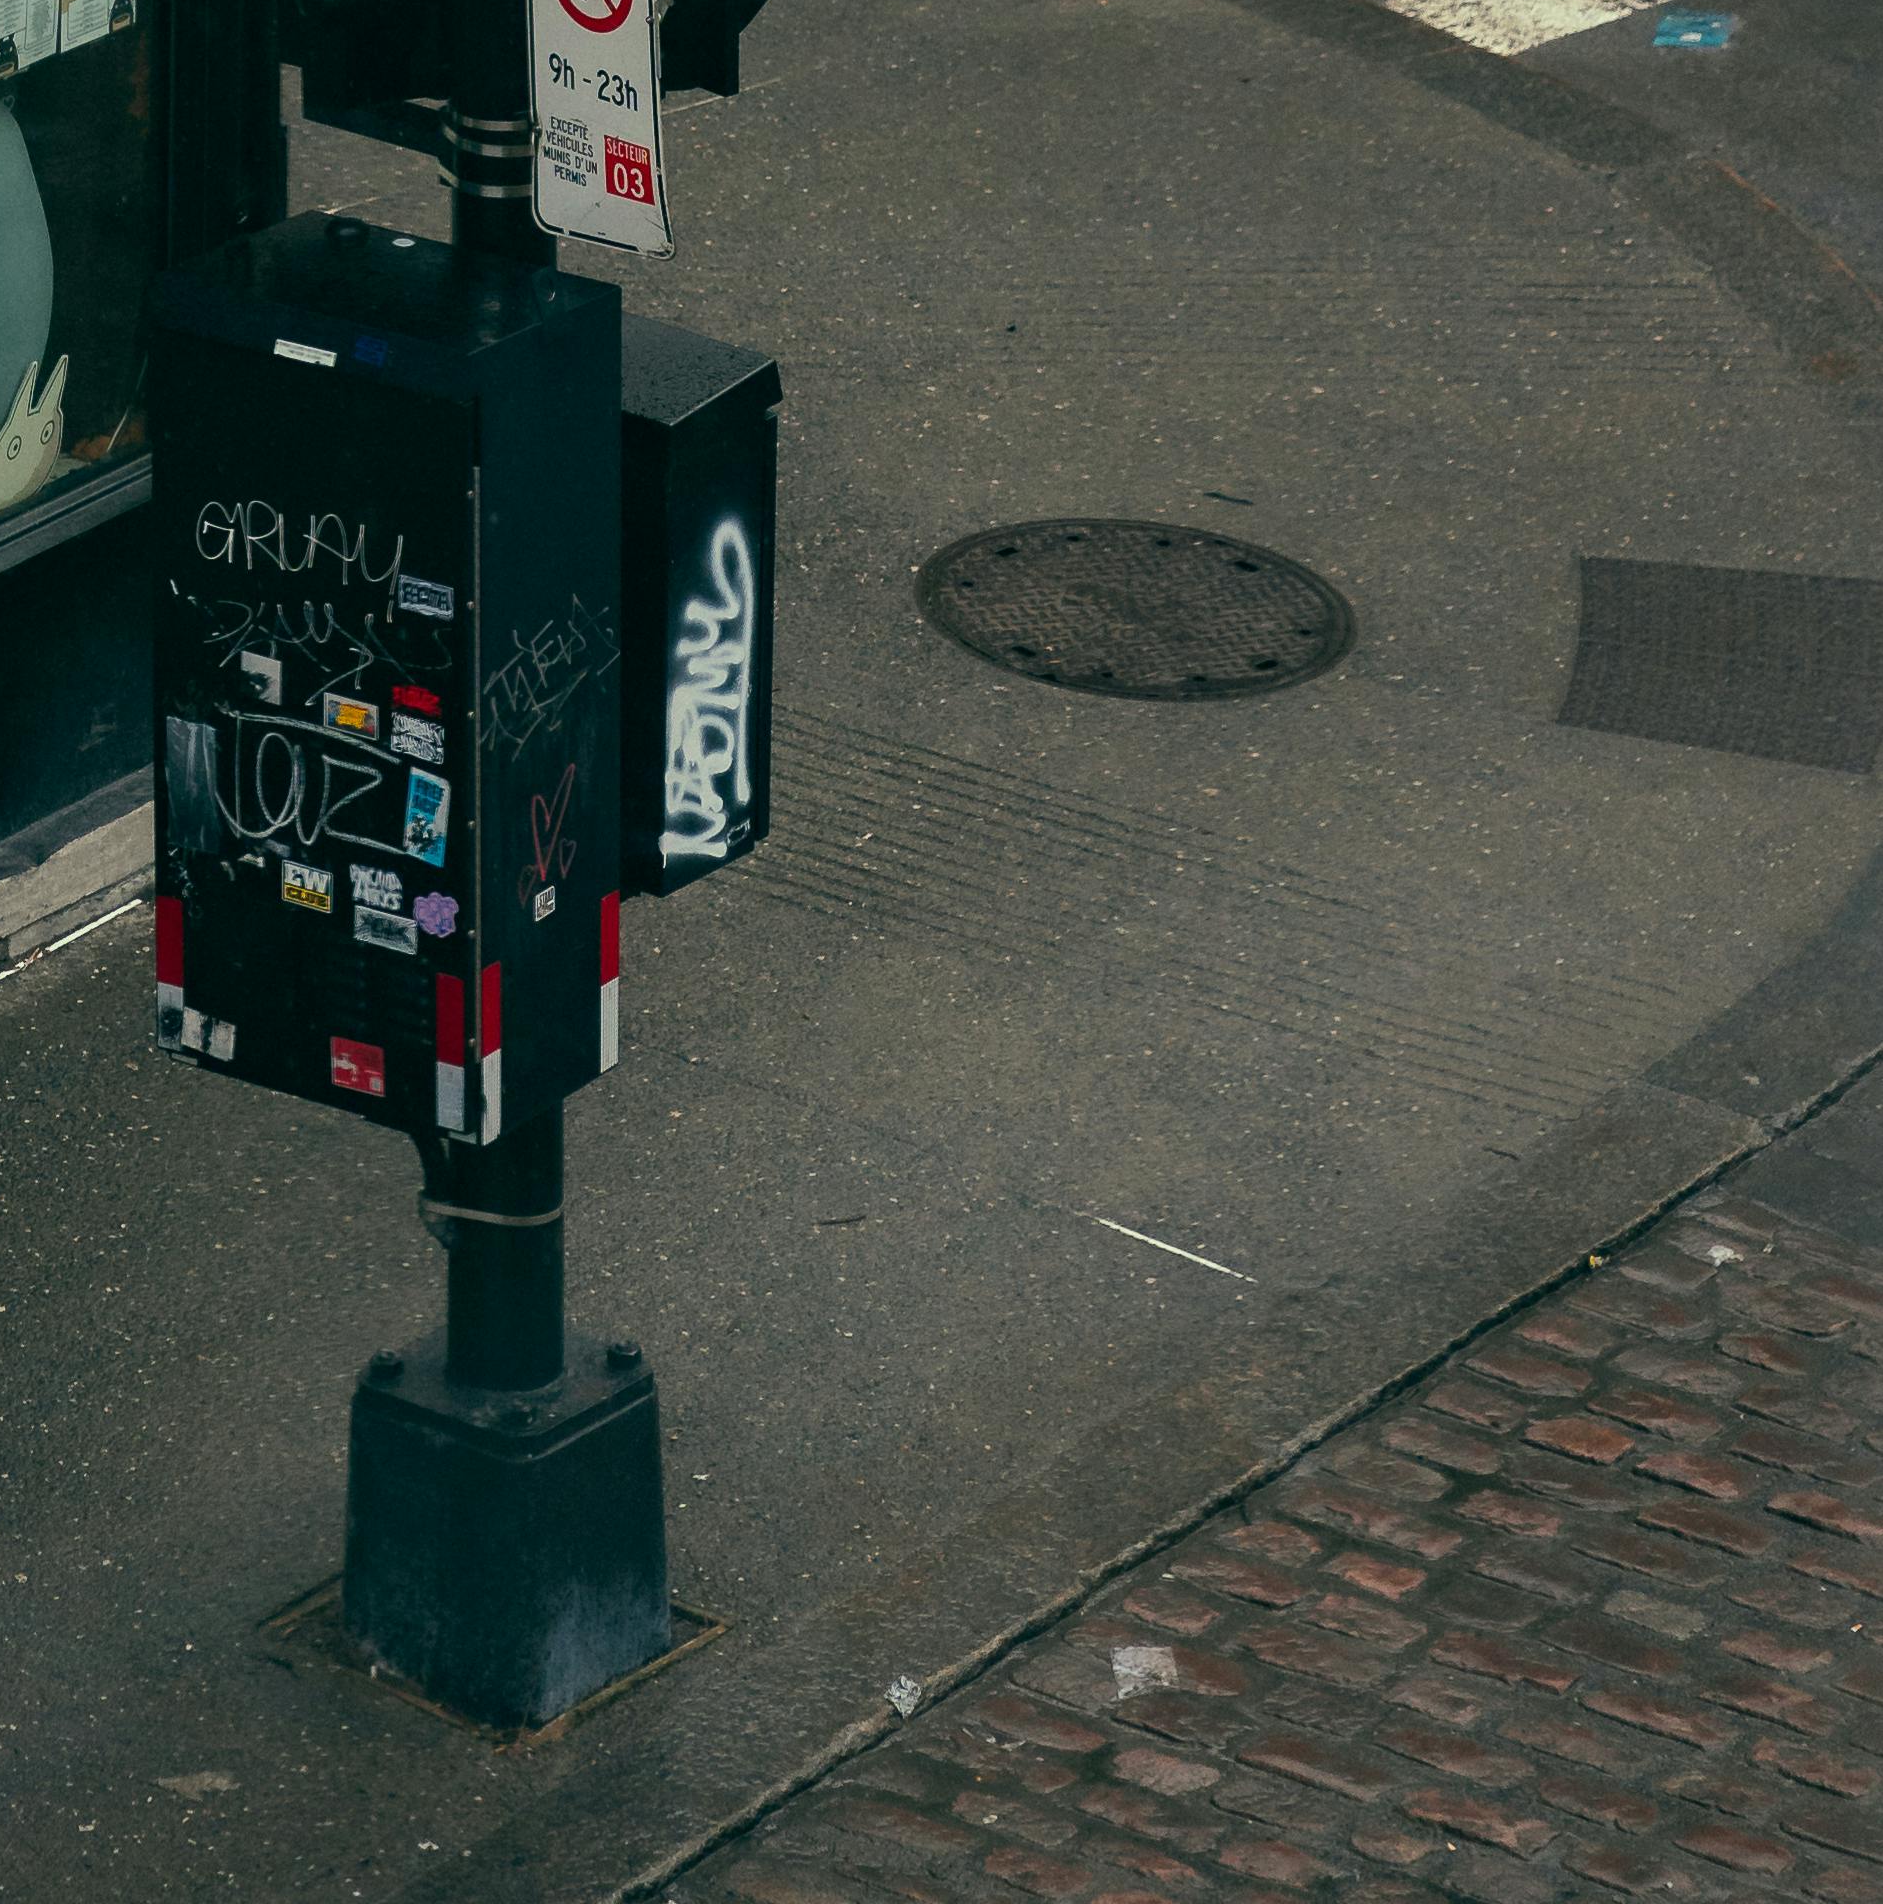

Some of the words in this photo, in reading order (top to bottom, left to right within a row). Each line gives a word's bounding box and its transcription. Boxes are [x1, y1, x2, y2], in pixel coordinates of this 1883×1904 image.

[548, 52, 576, 91] 9h
[596, 68, 638, 112] 23h
[550, 115, 589, 142] EXCEPTÉ
[543, 144, 572, 167] MUNIS
[545, 130, 594, 159] VÉHICULES
[553, 164, 587, 188] PERMIS
[613, 162, 646, 199] 03
